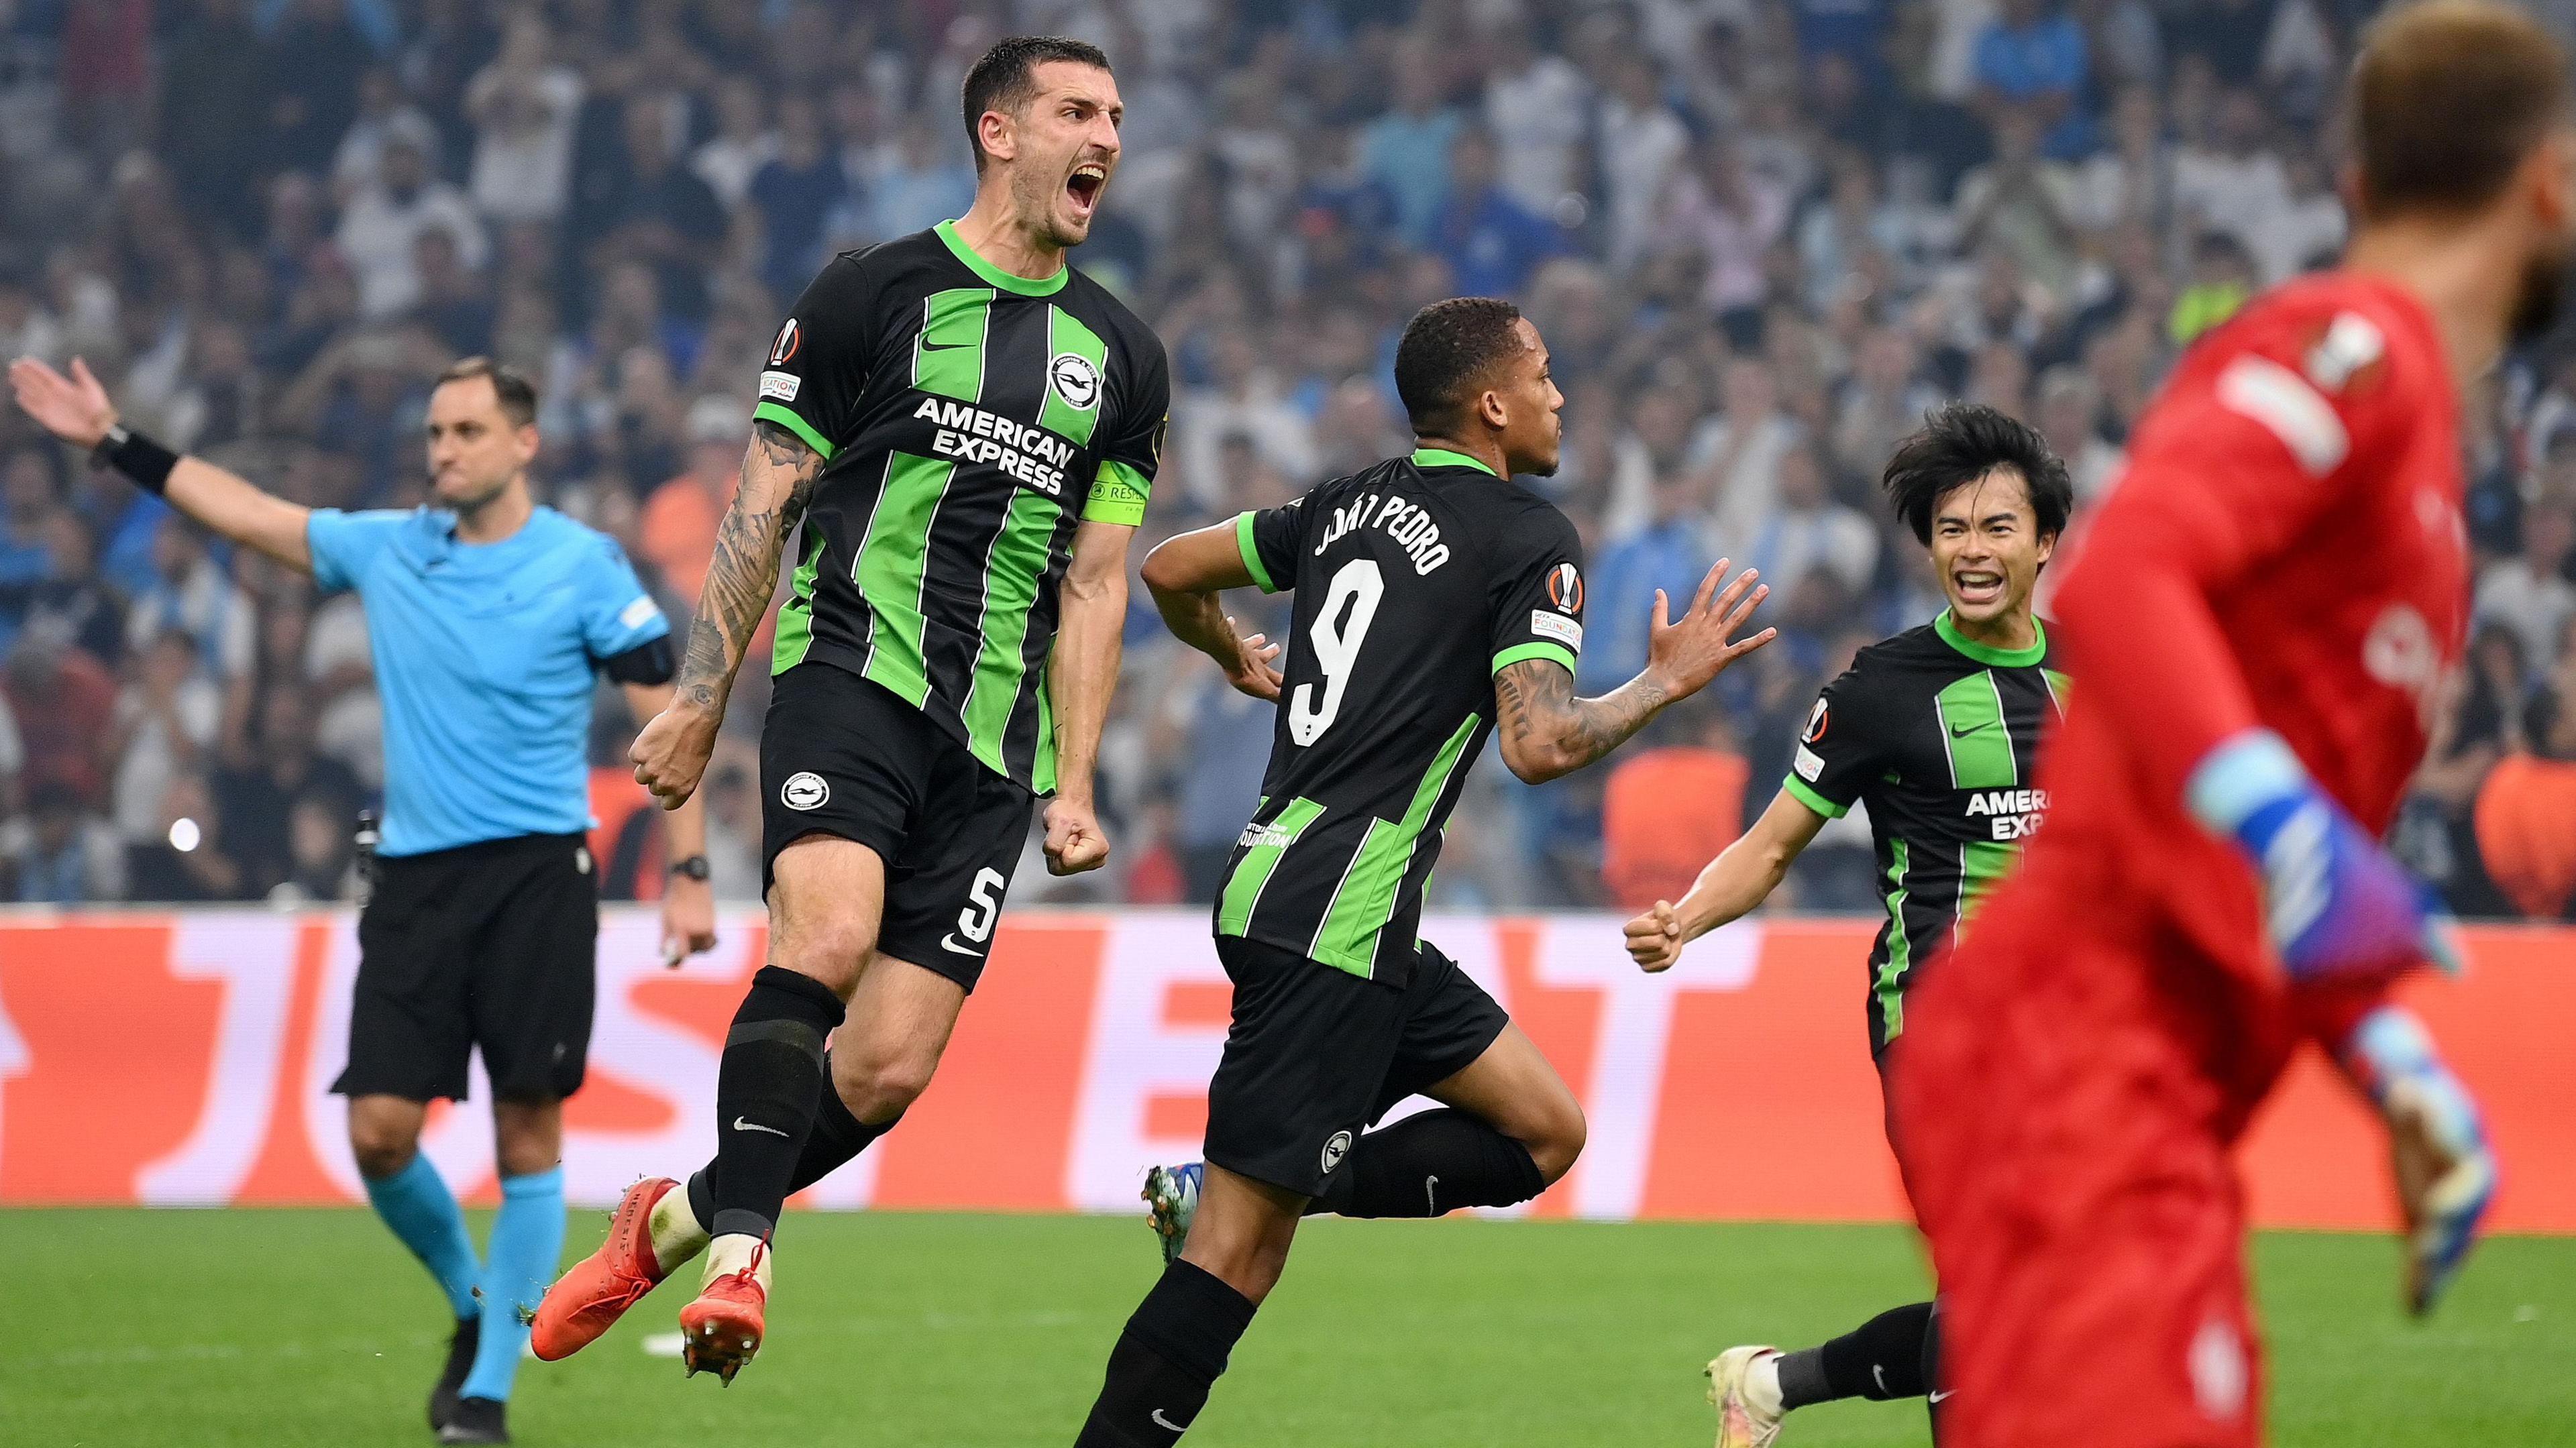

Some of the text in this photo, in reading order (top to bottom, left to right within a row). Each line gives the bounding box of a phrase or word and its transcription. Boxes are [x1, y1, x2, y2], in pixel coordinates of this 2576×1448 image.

[913, 398, 1075, 469] AMERICAN
[932, 429, 1064, 496] EXPRESS
[1371, 496, 1450, 576] PEDRO
[1289, 559, 1385, 747] 9
[958, 867, 1004, 943] 5
[132, 911, 885, 1206] JUS
